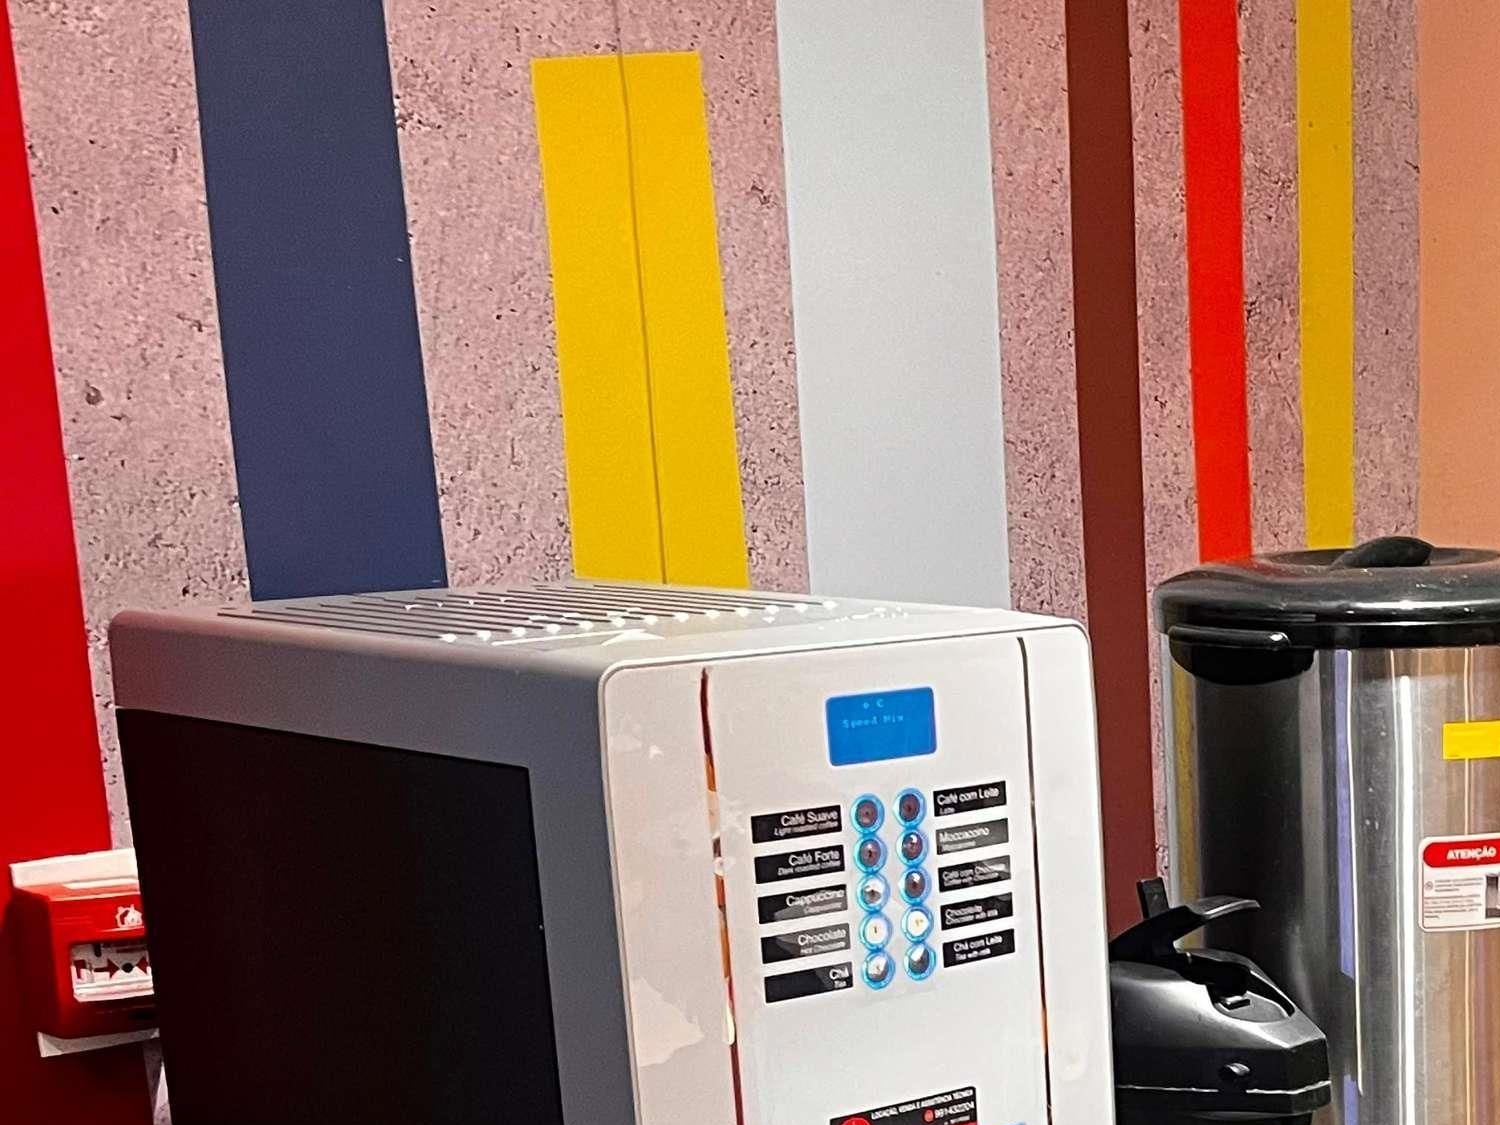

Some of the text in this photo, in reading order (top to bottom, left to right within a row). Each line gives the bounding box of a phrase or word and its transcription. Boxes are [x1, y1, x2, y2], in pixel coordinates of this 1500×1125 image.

[781, 810, 838, 827] Café Suave
[788, 850, 840, 866] Café Forte
[1446, 845, 1498, 861] ATENÇÃO
